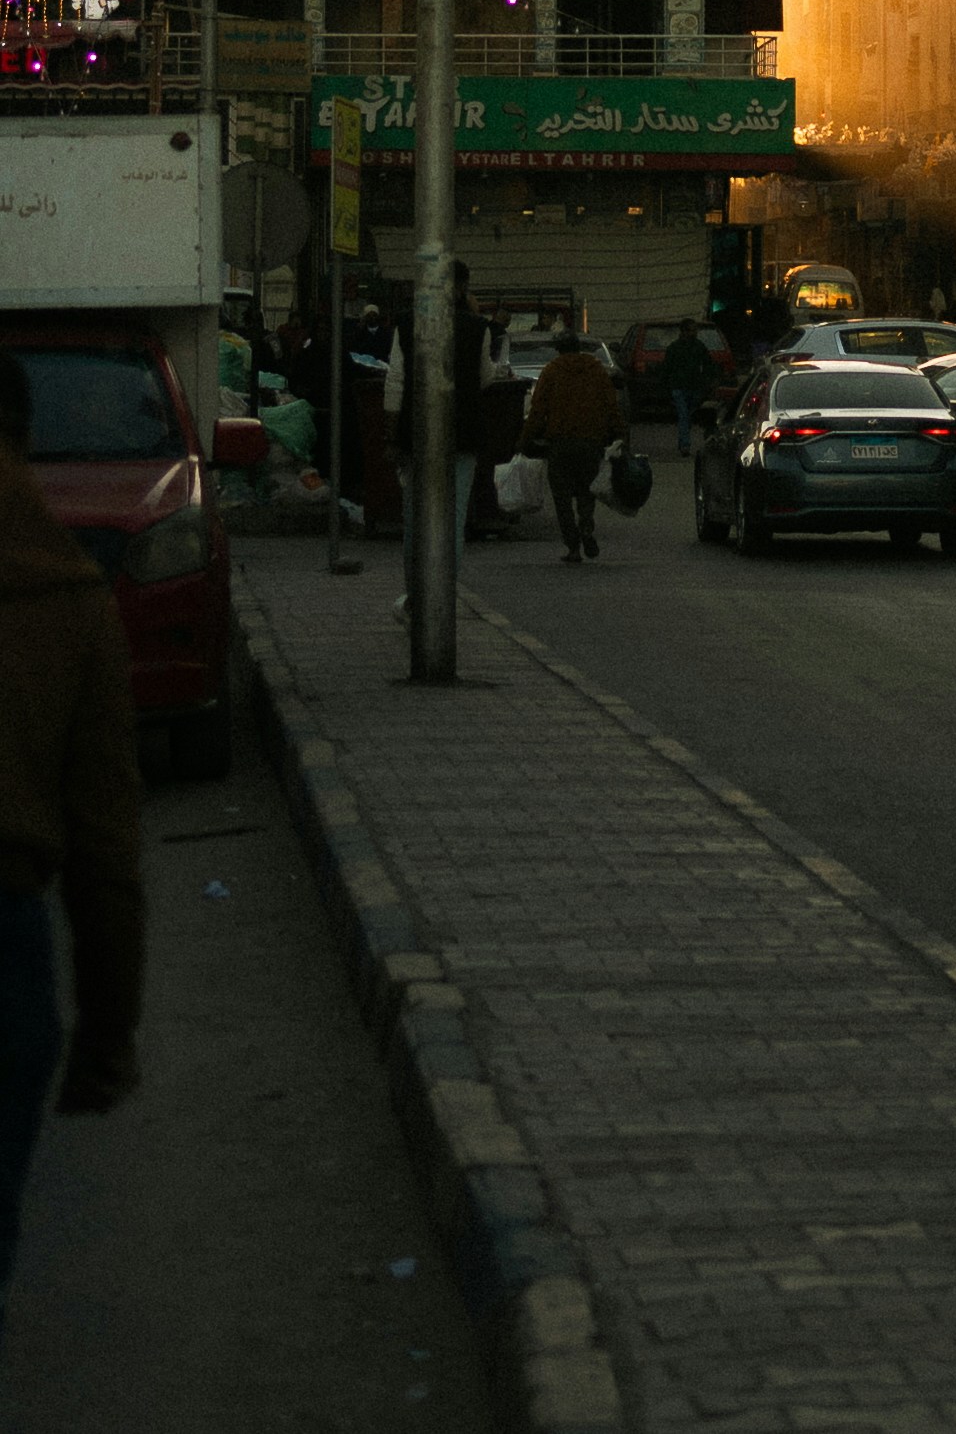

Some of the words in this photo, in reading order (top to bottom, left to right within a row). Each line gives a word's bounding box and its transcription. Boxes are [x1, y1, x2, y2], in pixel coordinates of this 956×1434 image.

[362, 74, 460, 100] ST
[352, 95, 486, 134] TAIR
[535, 103, 622, 139] التحرير
[630, 101, 700, 134] ستار
[361, 151, 470, 166] OSHY
[543, 152, 646, 166] TAHRIR
